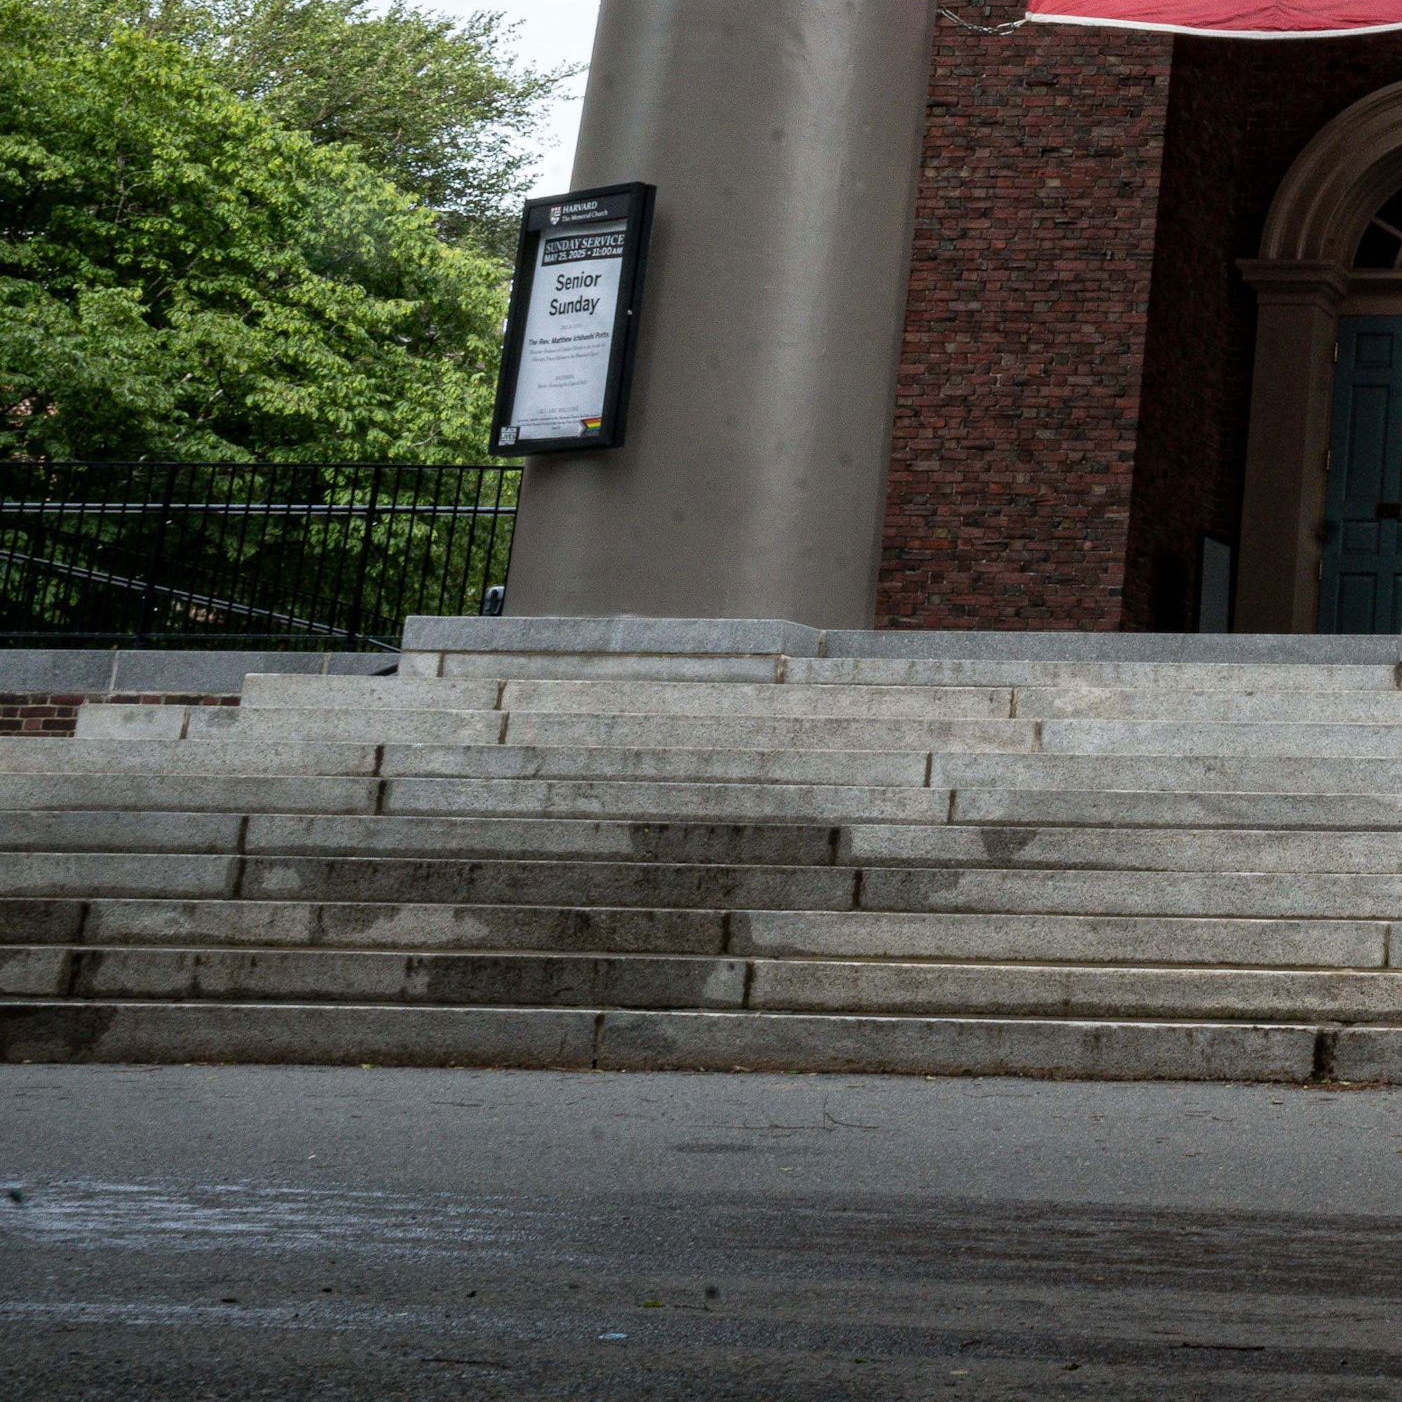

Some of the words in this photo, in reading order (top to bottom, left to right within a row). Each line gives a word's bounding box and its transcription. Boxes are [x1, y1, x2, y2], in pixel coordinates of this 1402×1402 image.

[562, 201, 598, 213] HARVARD
[545, 238, 581, 253] SUNDAY
[581, 234, 625, 248] SERVICE
[544, 254, 558, 263] MAY
[568, 249, 586, 259] 2025
[555, 271, 602, 291] Senior
[549, 295, 600, 316] Sunday
